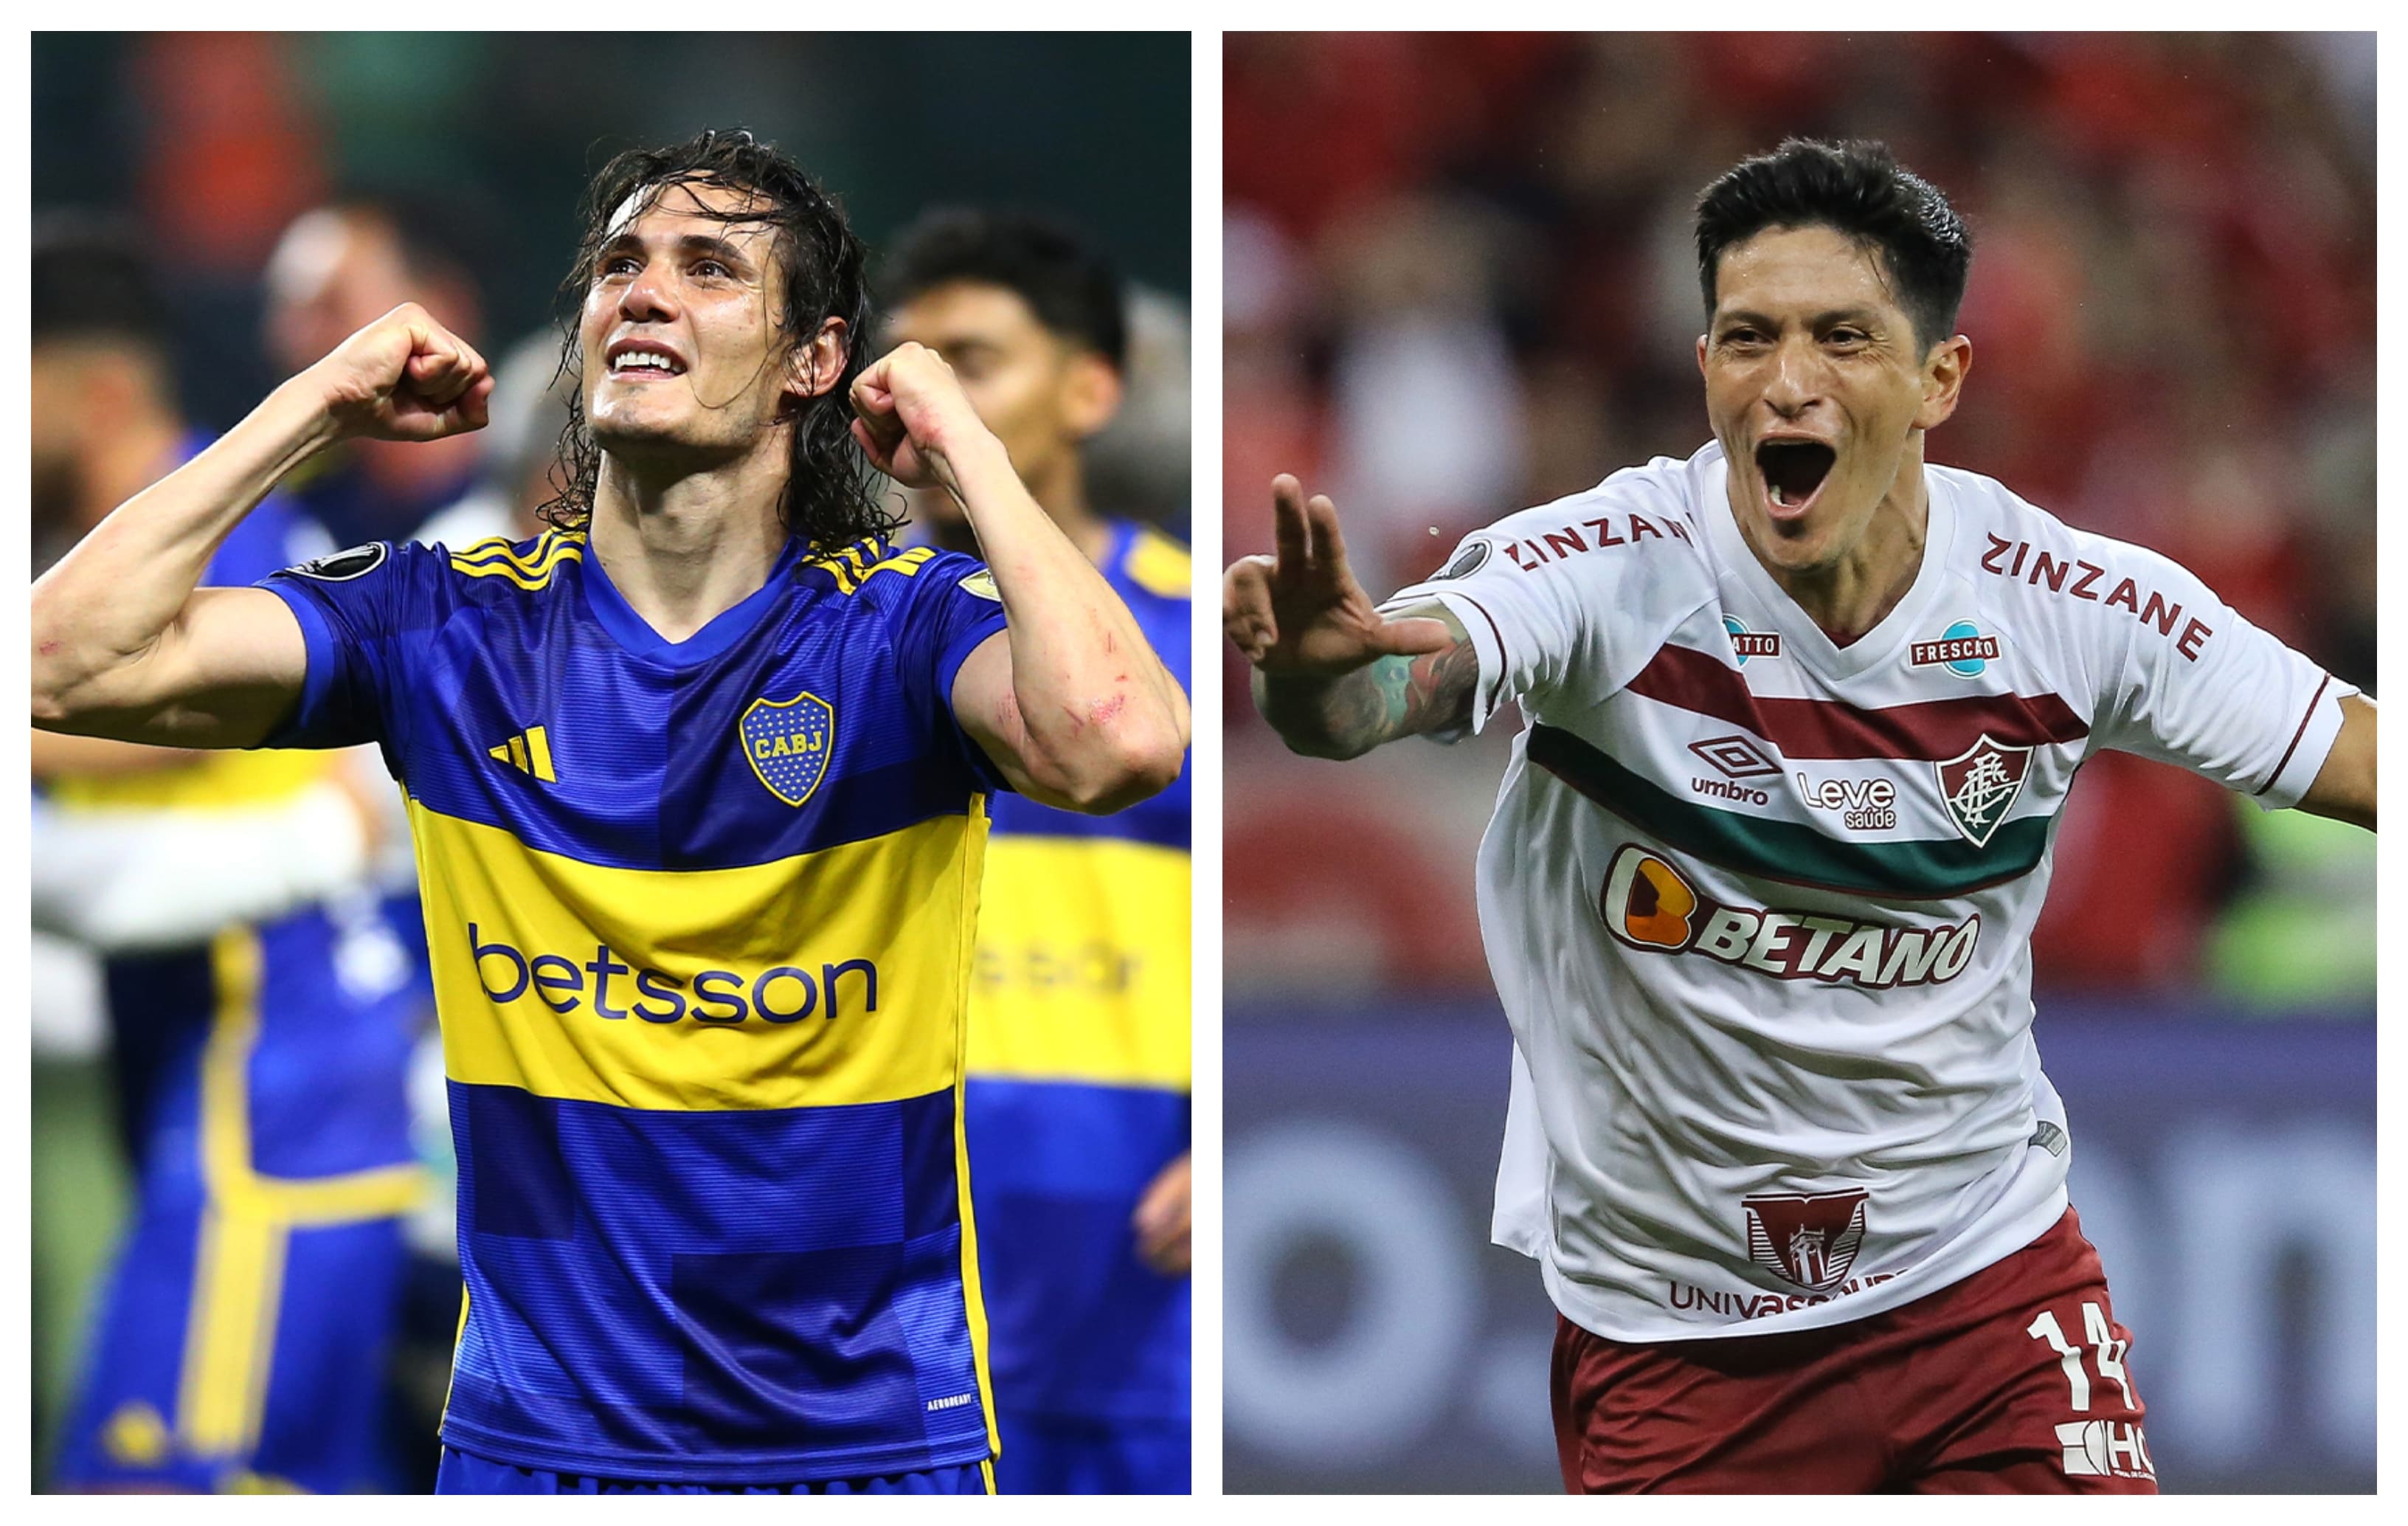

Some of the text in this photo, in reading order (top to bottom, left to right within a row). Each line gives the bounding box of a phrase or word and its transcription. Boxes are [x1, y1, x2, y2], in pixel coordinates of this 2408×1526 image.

[1504, 513, 1695, 572] ZINZAN
[1982, 531, 2212, 662] ZINZANE
[1733, 636, 1775, 653] ATTO
[754, 730, 822, 760] CABJ
[1691, 777, 1768, 806] umbro
[1797, 772, 1896, 809] Leve
[1845, 807, 1896, 829] saúde
[1693, 907, 1982, 987] BETANO
[468, 922, 876, 1023] betsson
[2027, 1302, 2136, 1412] 14
